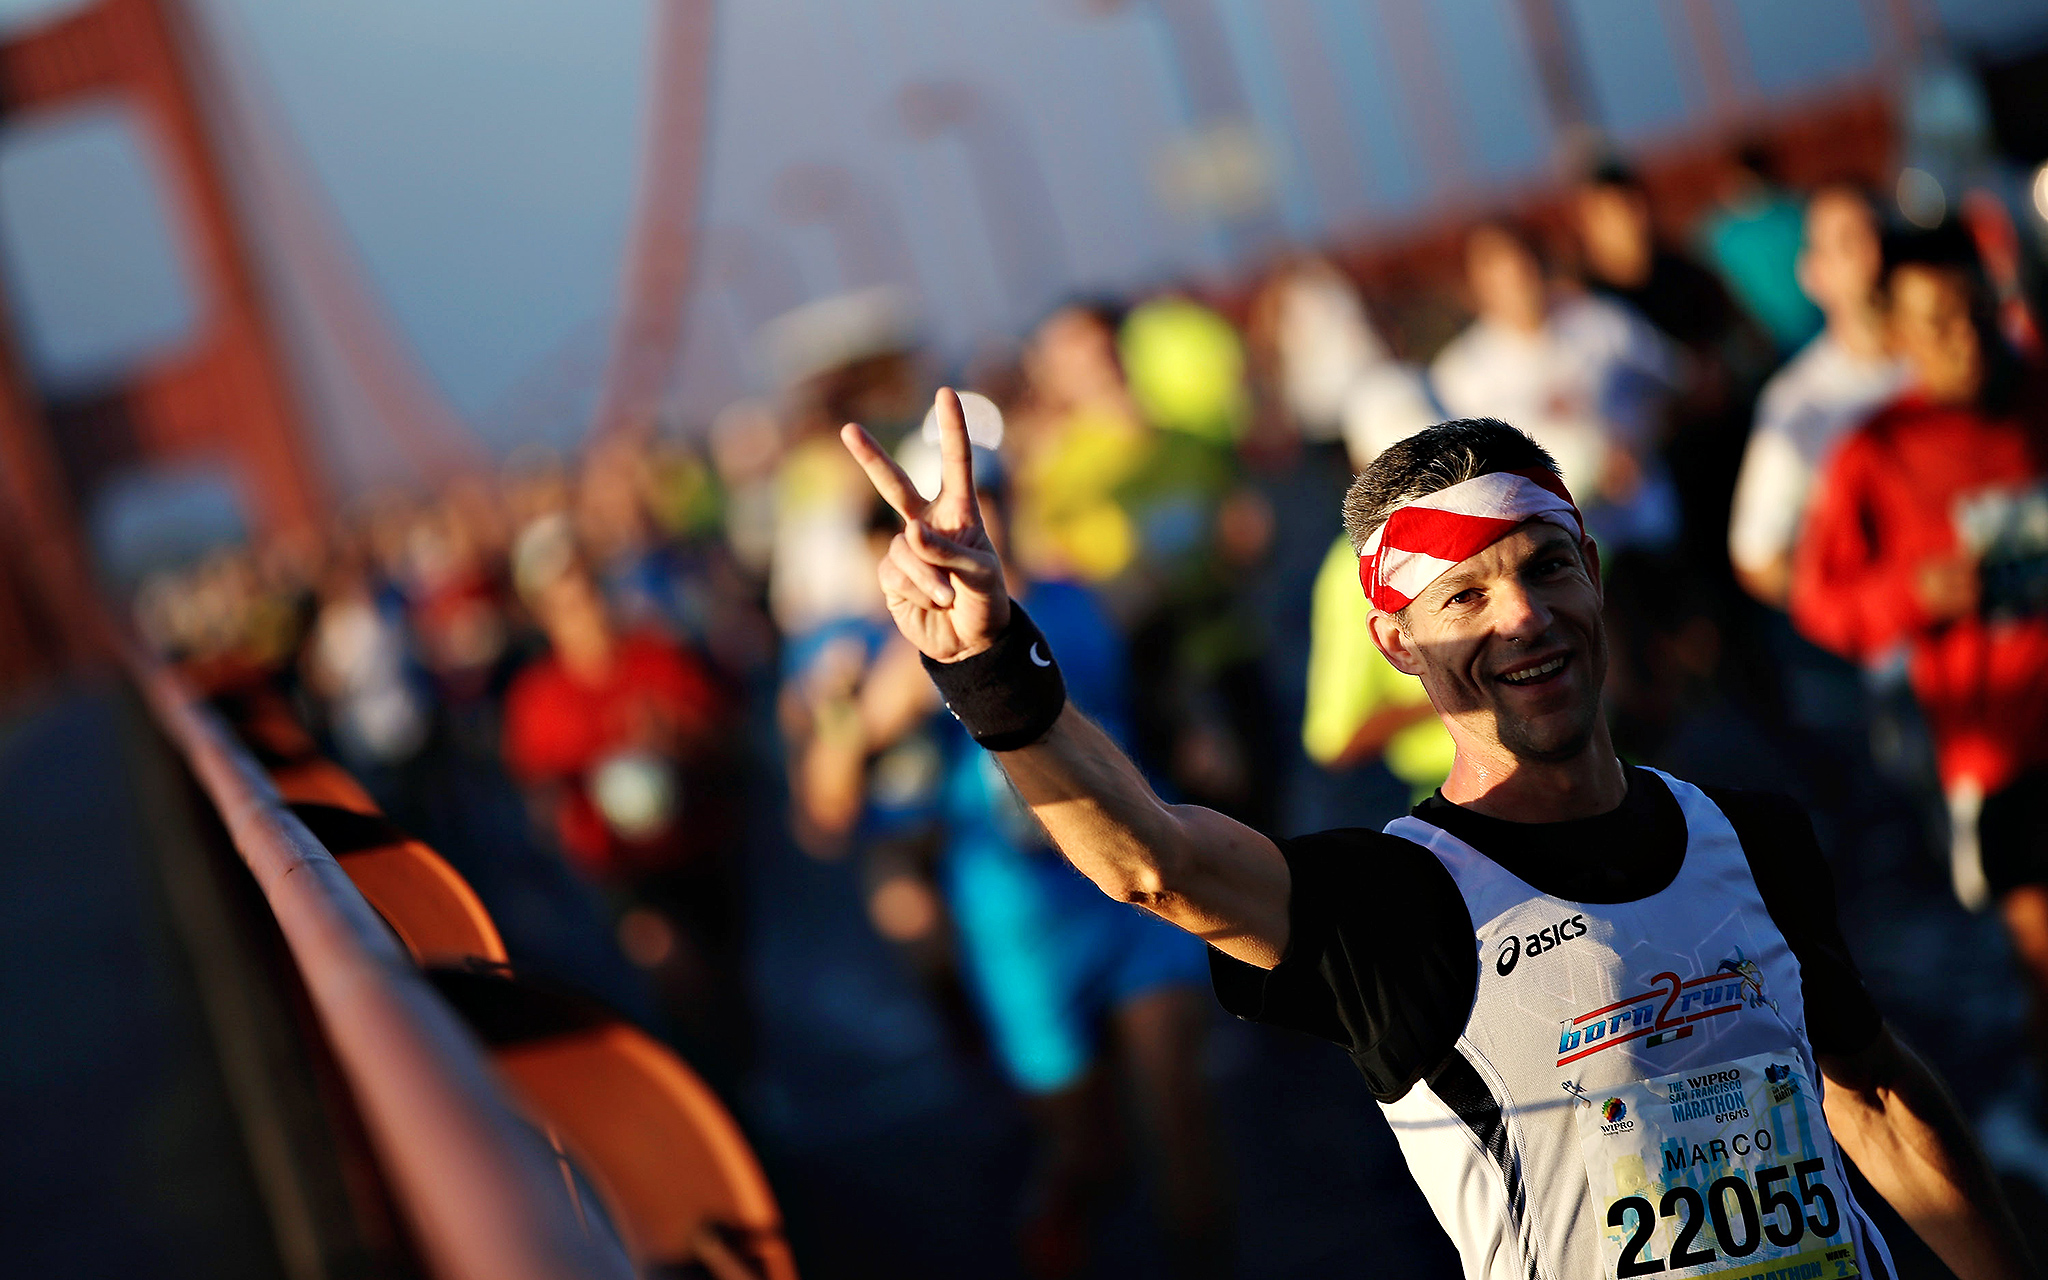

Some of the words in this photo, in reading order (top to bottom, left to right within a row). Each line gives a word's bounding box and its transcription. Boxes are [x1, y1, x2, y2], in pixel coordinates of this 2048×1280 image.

[1525, 914, 1587, 957] asics
[1667, 1081, 1684, 1093] THE
[1686, 1069, 1740, 1089] WIPRO
[1669, 1091, 1688, 1104] SAN
[1691, 1079, 1742, 1099] FRANCISCO
[1671, 1091, 1746, 1123] MARATHON
[1715, 1108, 1749, 1124] 6/16/13
[1600, 1120, 1634, 1133] WIPRO
[1665, 1129, 1772, 1172] MARCO
[1606, 1156, 1840, 1280] 22055
[1733, 1261, 1823, 1280] RATHON
[1835, 1260, 1849, 1277] 2
